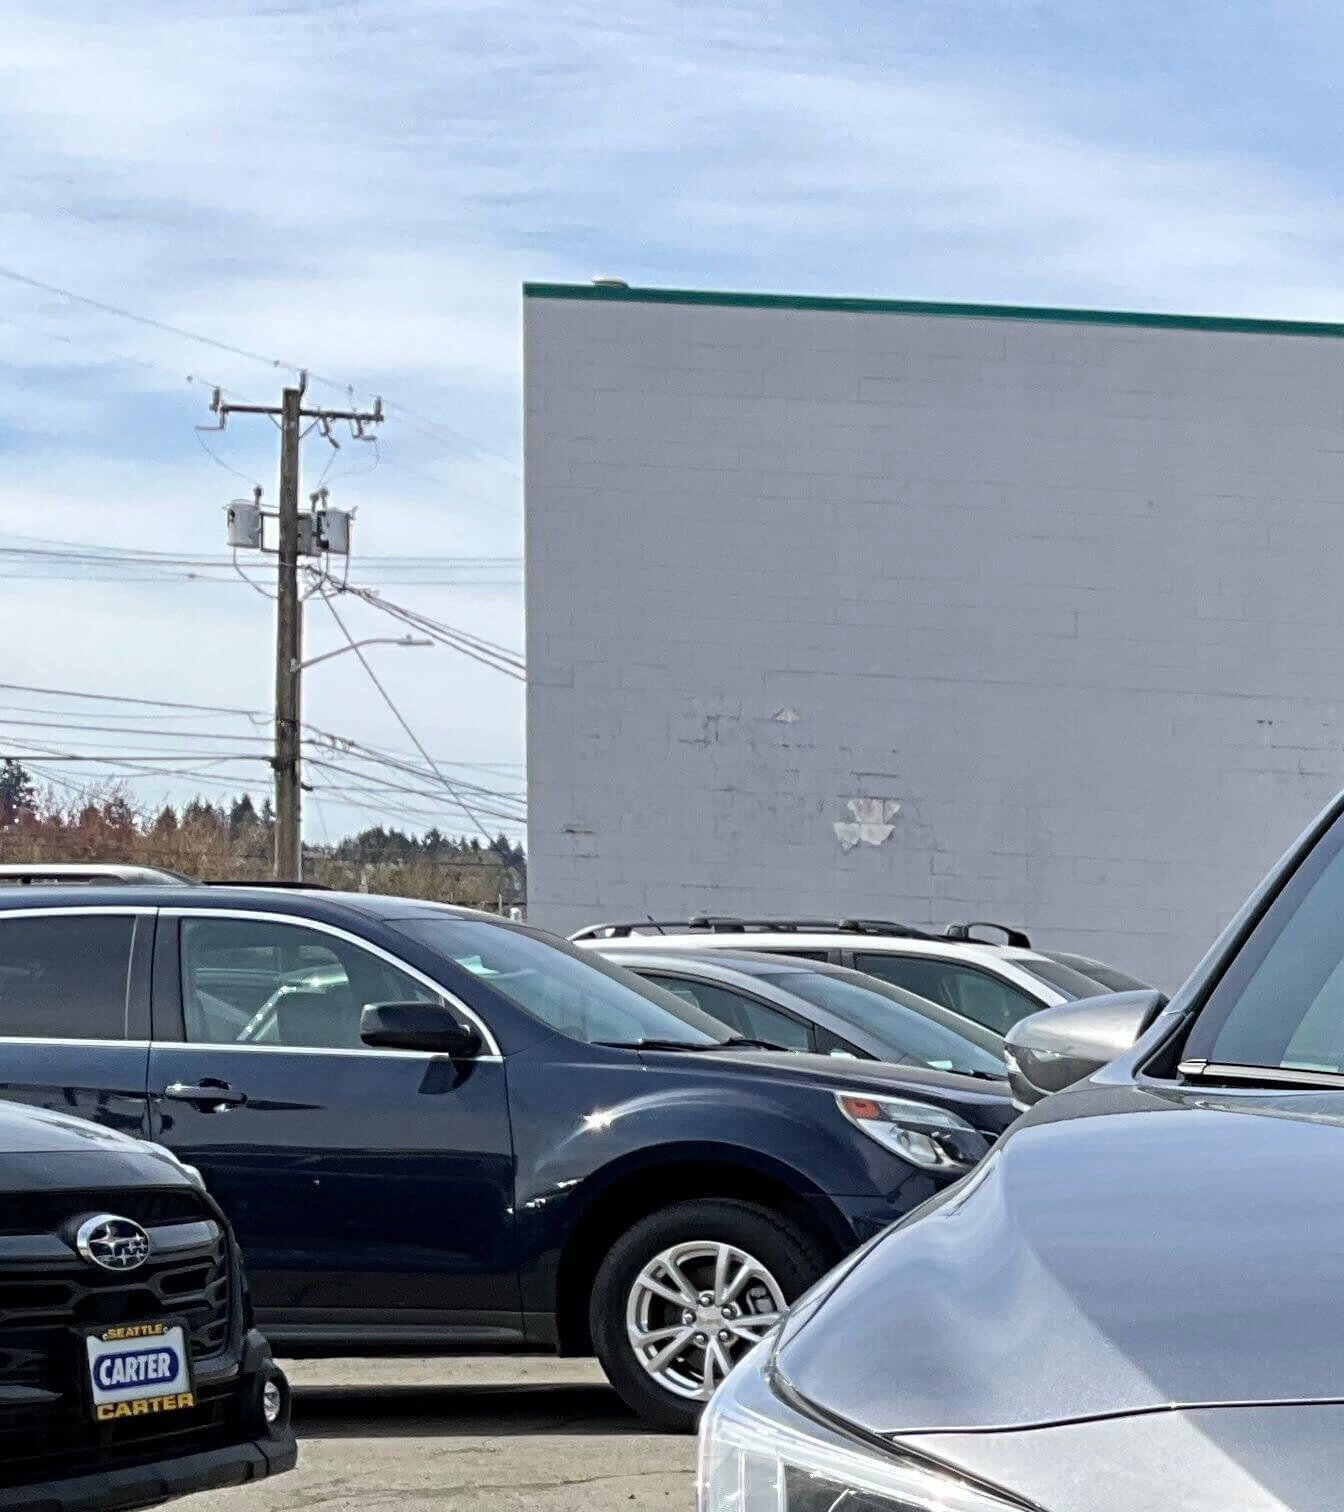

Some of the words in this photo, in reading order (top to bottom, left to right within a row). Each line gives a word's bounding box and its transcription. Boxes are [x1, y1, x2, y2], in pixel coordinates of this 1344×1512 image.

[107, 1324, 163, 1339] SEATTLE
[100, 1352, 171, 1386] CARTER
[97, 1393, 194, 1420] CARTER
